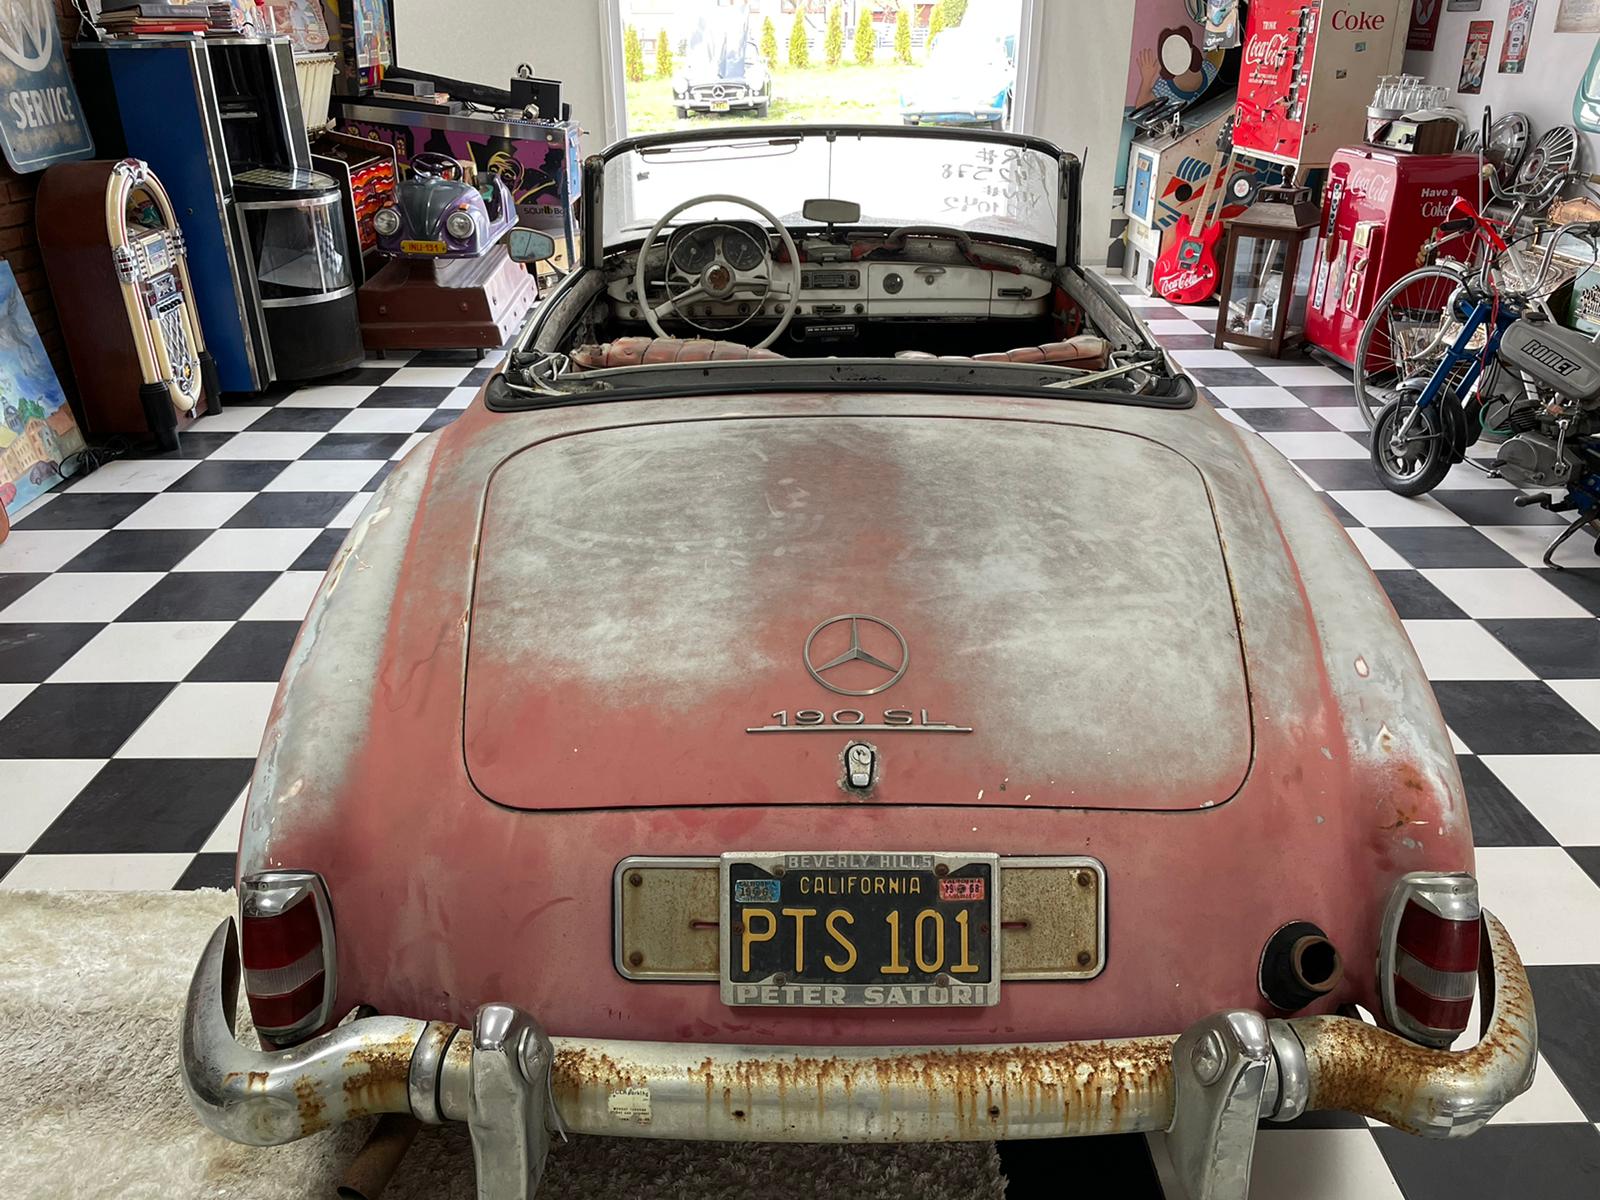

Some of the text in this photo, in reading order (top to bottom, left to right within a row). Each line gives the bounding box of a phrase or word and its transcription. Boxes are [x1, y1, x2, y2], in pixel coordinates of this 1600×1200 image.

[1331, 9, 1385, 31] Coke
[9, 86, 76, 130] SERVICE
[1420, 188, 1459, 198] Have a
[1421, 201, 1450, 218] Coke
[1520, 339, 1582, 376] ROMET
[771, 708, 947, 726] 190 SL
[787, 855, 932, 869] BEVERLY HILLS
[800, 876, 921, 895] CALIFORNIA
[741, 907, 979, 974] PTS 101
[736, 985, 985, 1005] PETER SATORI
